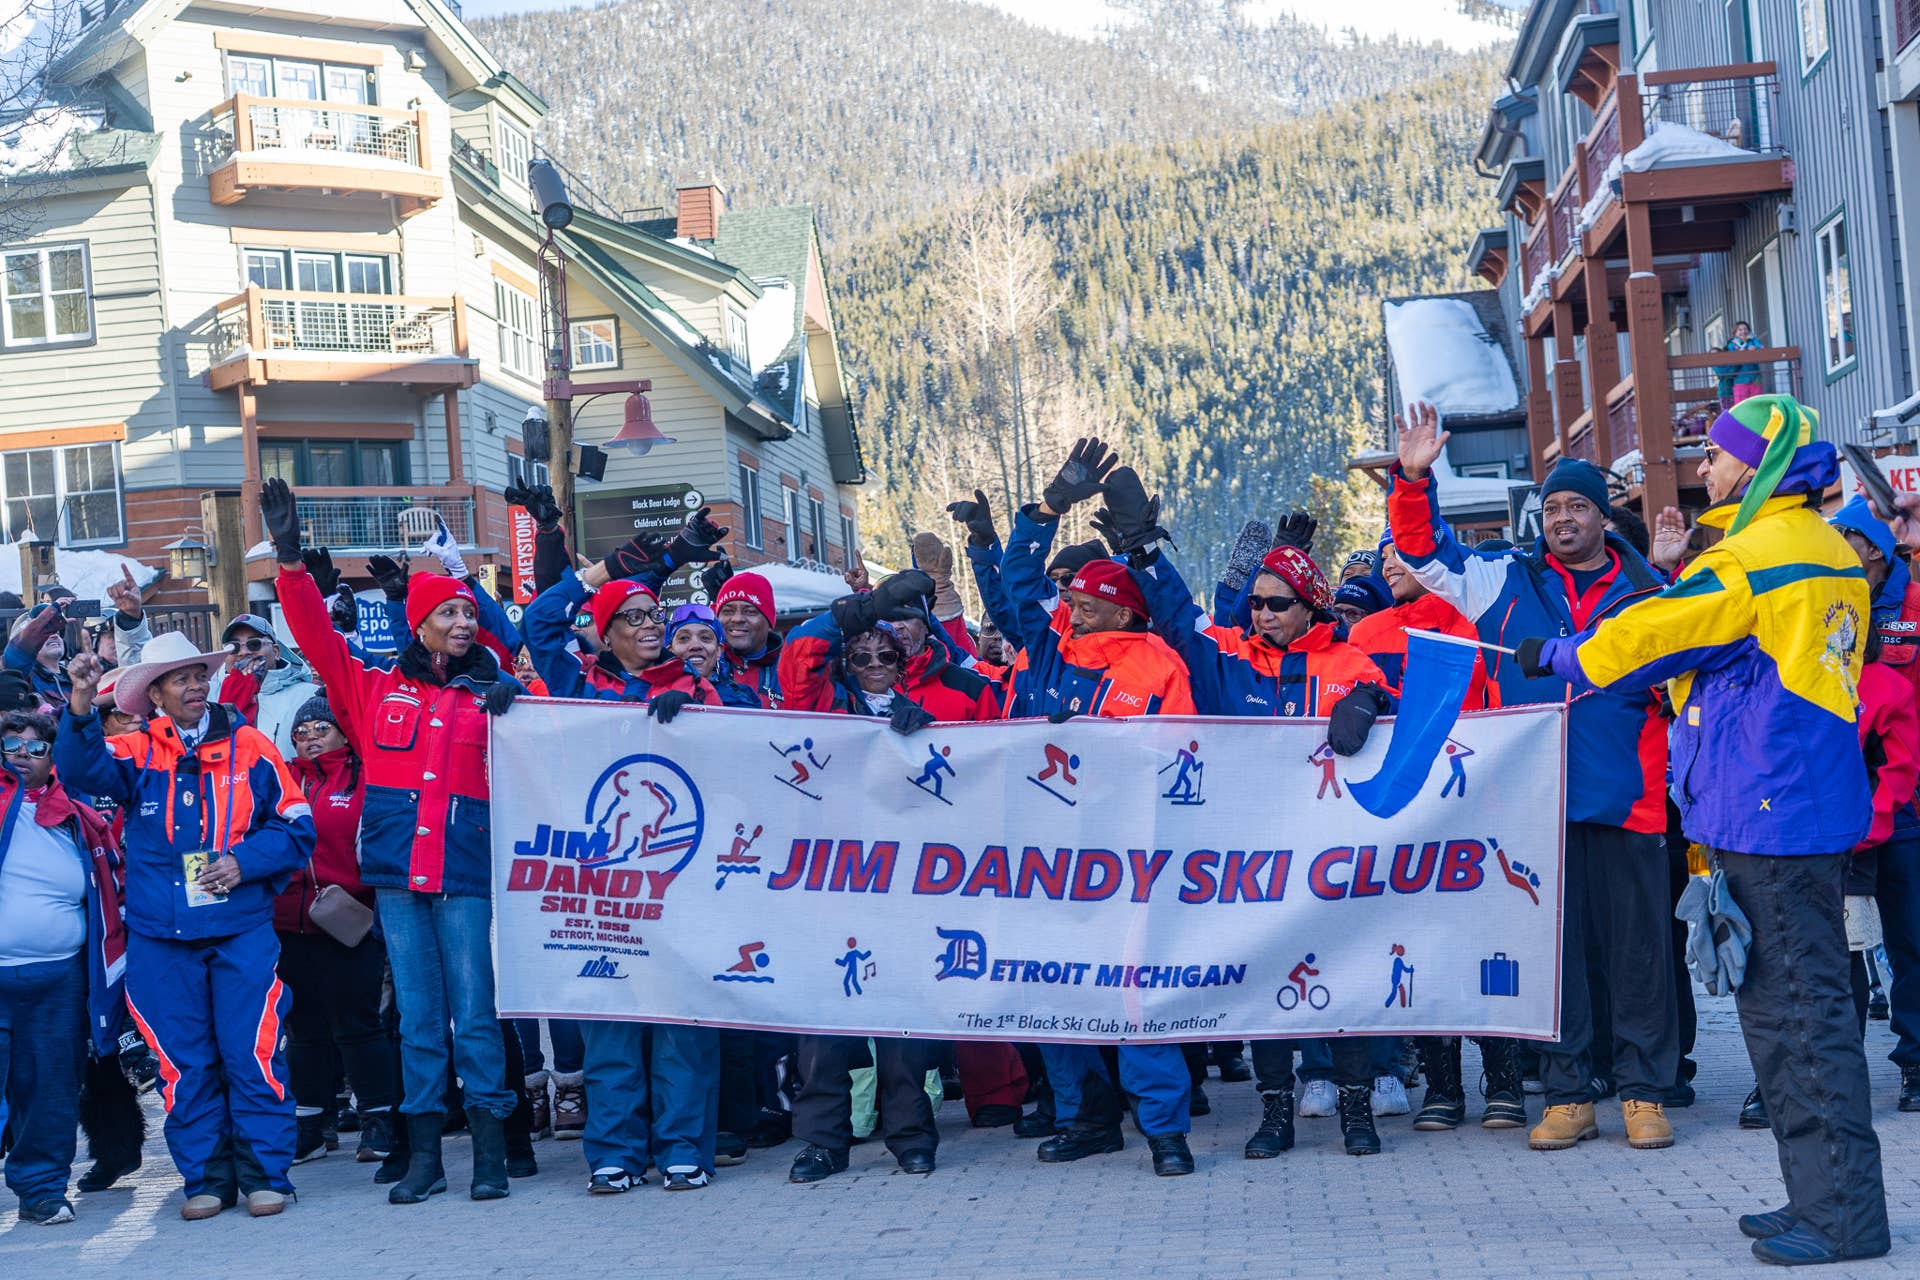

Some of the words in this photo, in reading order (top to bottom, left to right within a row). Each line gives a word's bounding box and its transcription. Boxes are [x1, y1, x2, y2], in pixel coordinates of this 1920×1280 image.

[632, 499, 648, 510] Black
[649, 499, 662, 509] Bear
[663, 496, 681, 508] Lodge
[634, 518, 662, 529] Children's
[663, 516, 681, 527] Center
[514, 510, 535, 576] KEYSTONE
[667, 576, 686, 586] Center
[1099, 583, 1118, 596] ROOTS
[667, 597, 687, 607] Station
[1113, 691, 1142, 707] JDSC
[514, 824, 611, 860] JIM
[767, 838, 900, 893] JIM
[912, 842, 1173, 903] DANDY
[1178, 849, 1293, 904] SKI
[1308, 838, 1487, 900] CLUB
[507, 859, 677, 900] DANDY
[540, 895, 587, 914] SKI
[594, 900, 664, 920] CLUB
[565, 918, 594, 929] EST.
[598, 920, 630, 933] 1958
[550, 929, 594, 941] DETROIT,
[596, 933, 643, 945] MICHIGAN
[936, 927, 1090, 985] DETROIT
[1095, 964, 1247, 988] MICHIGAN
[957, 1013, 993, 1029] “The
[996, 1014, 1015, 1029] 1st
[1018, 1014, 1059, 1031] Black
[1061, 1016, 1082, 1032] Ski
[1087, 1017, 1119, 1033] Club
[1123, 1021, 1138, 1033] In
[1143, 1018, 1165, 1033] the
[1170, 1013, 1227, 1031] nation”
